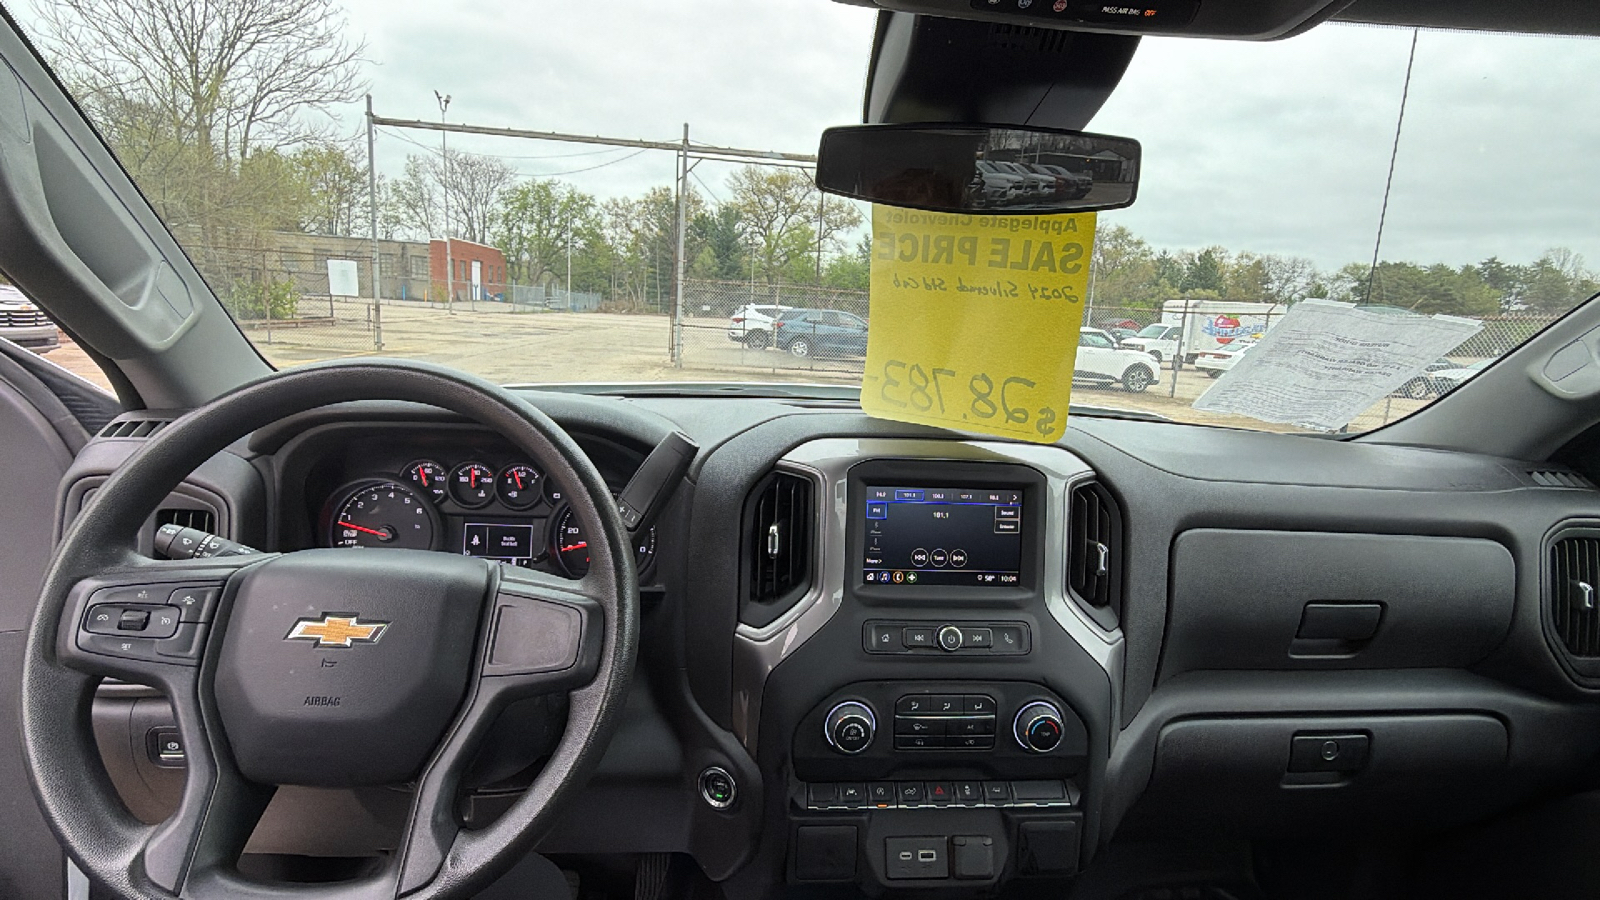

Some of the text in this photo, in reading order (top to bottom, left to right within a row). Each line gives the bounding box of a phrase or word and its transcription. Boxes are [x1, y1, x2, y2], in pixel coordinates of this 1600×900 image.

[1101, 6, 1118, 14] PASS
[1144, 9, 1157, 17] OFF
[357, 501, 364, 509] 2
[303, 696, 341, 706] AIRBAG
